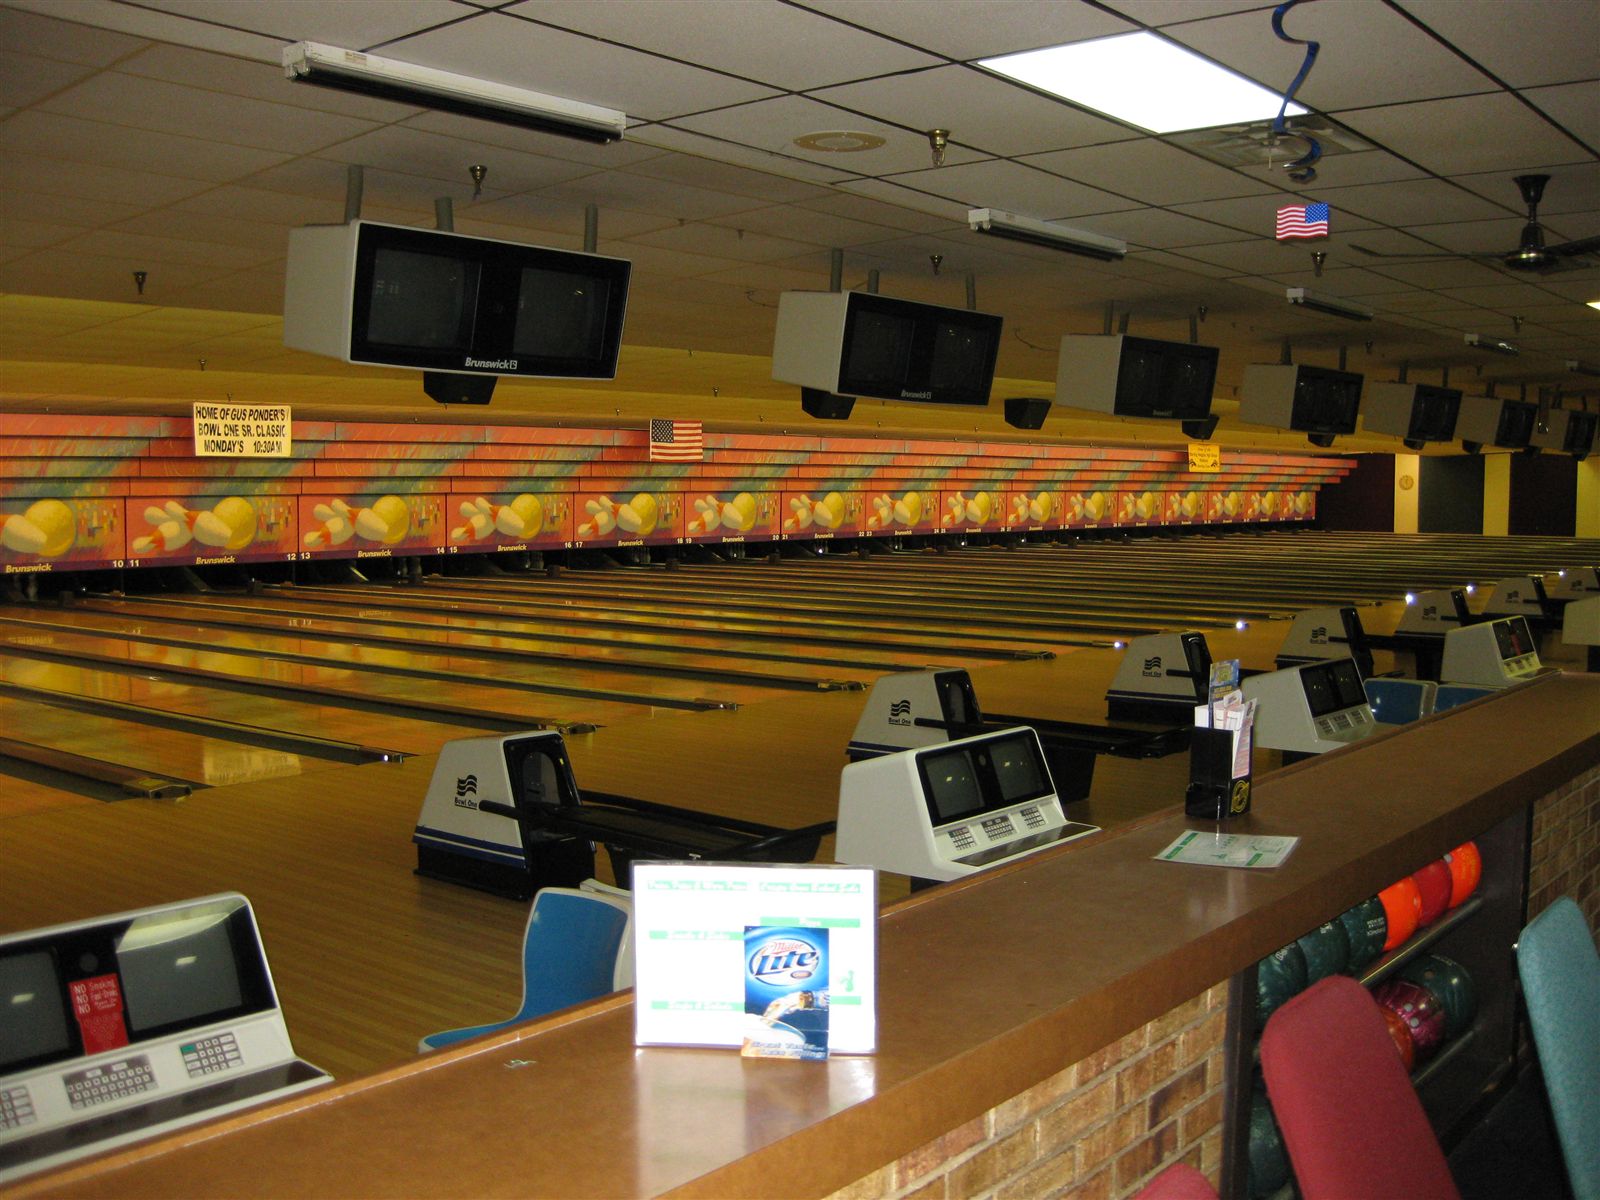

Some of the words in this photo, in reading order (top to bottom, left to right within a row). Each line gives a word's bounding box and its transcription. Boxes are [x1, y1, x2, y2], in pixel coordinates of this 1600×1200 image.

[465, 357, 509, 369] Brunswick
[196, 406, 218, 419] HOME
[220, 408, 230, 420] OF
[231, 408, 247, 420] GUS
[249, 409, 285, 421] PONDER'S
[199, 423, 221, 436] BOWL
[224, 424, 239, 436] ONE
[242, 425, 254, 437] SR.
[256, 425, 286, 437] CLASSIC
[204, 440, 244, 453] MONDAY'S
[254, 441, 282, 453] 10:30AM
[497, 543, 527, 552] Brunswick
[358, 549, 392, 558] Brunswick
[113, 560, 124, 568] 10
[130, 559, 139, 567] 11
[196, 556, 235, 565] Brunswick
[6, 563, 52, 573] Brunswick
[455, 797, 466, 805] Bowl
[754, 949, 817, 976] Lite
[74, 983, 86, 994] NO
[77, 993, 89, 1004] NO
[80, 1003, 91, 1014] NO
